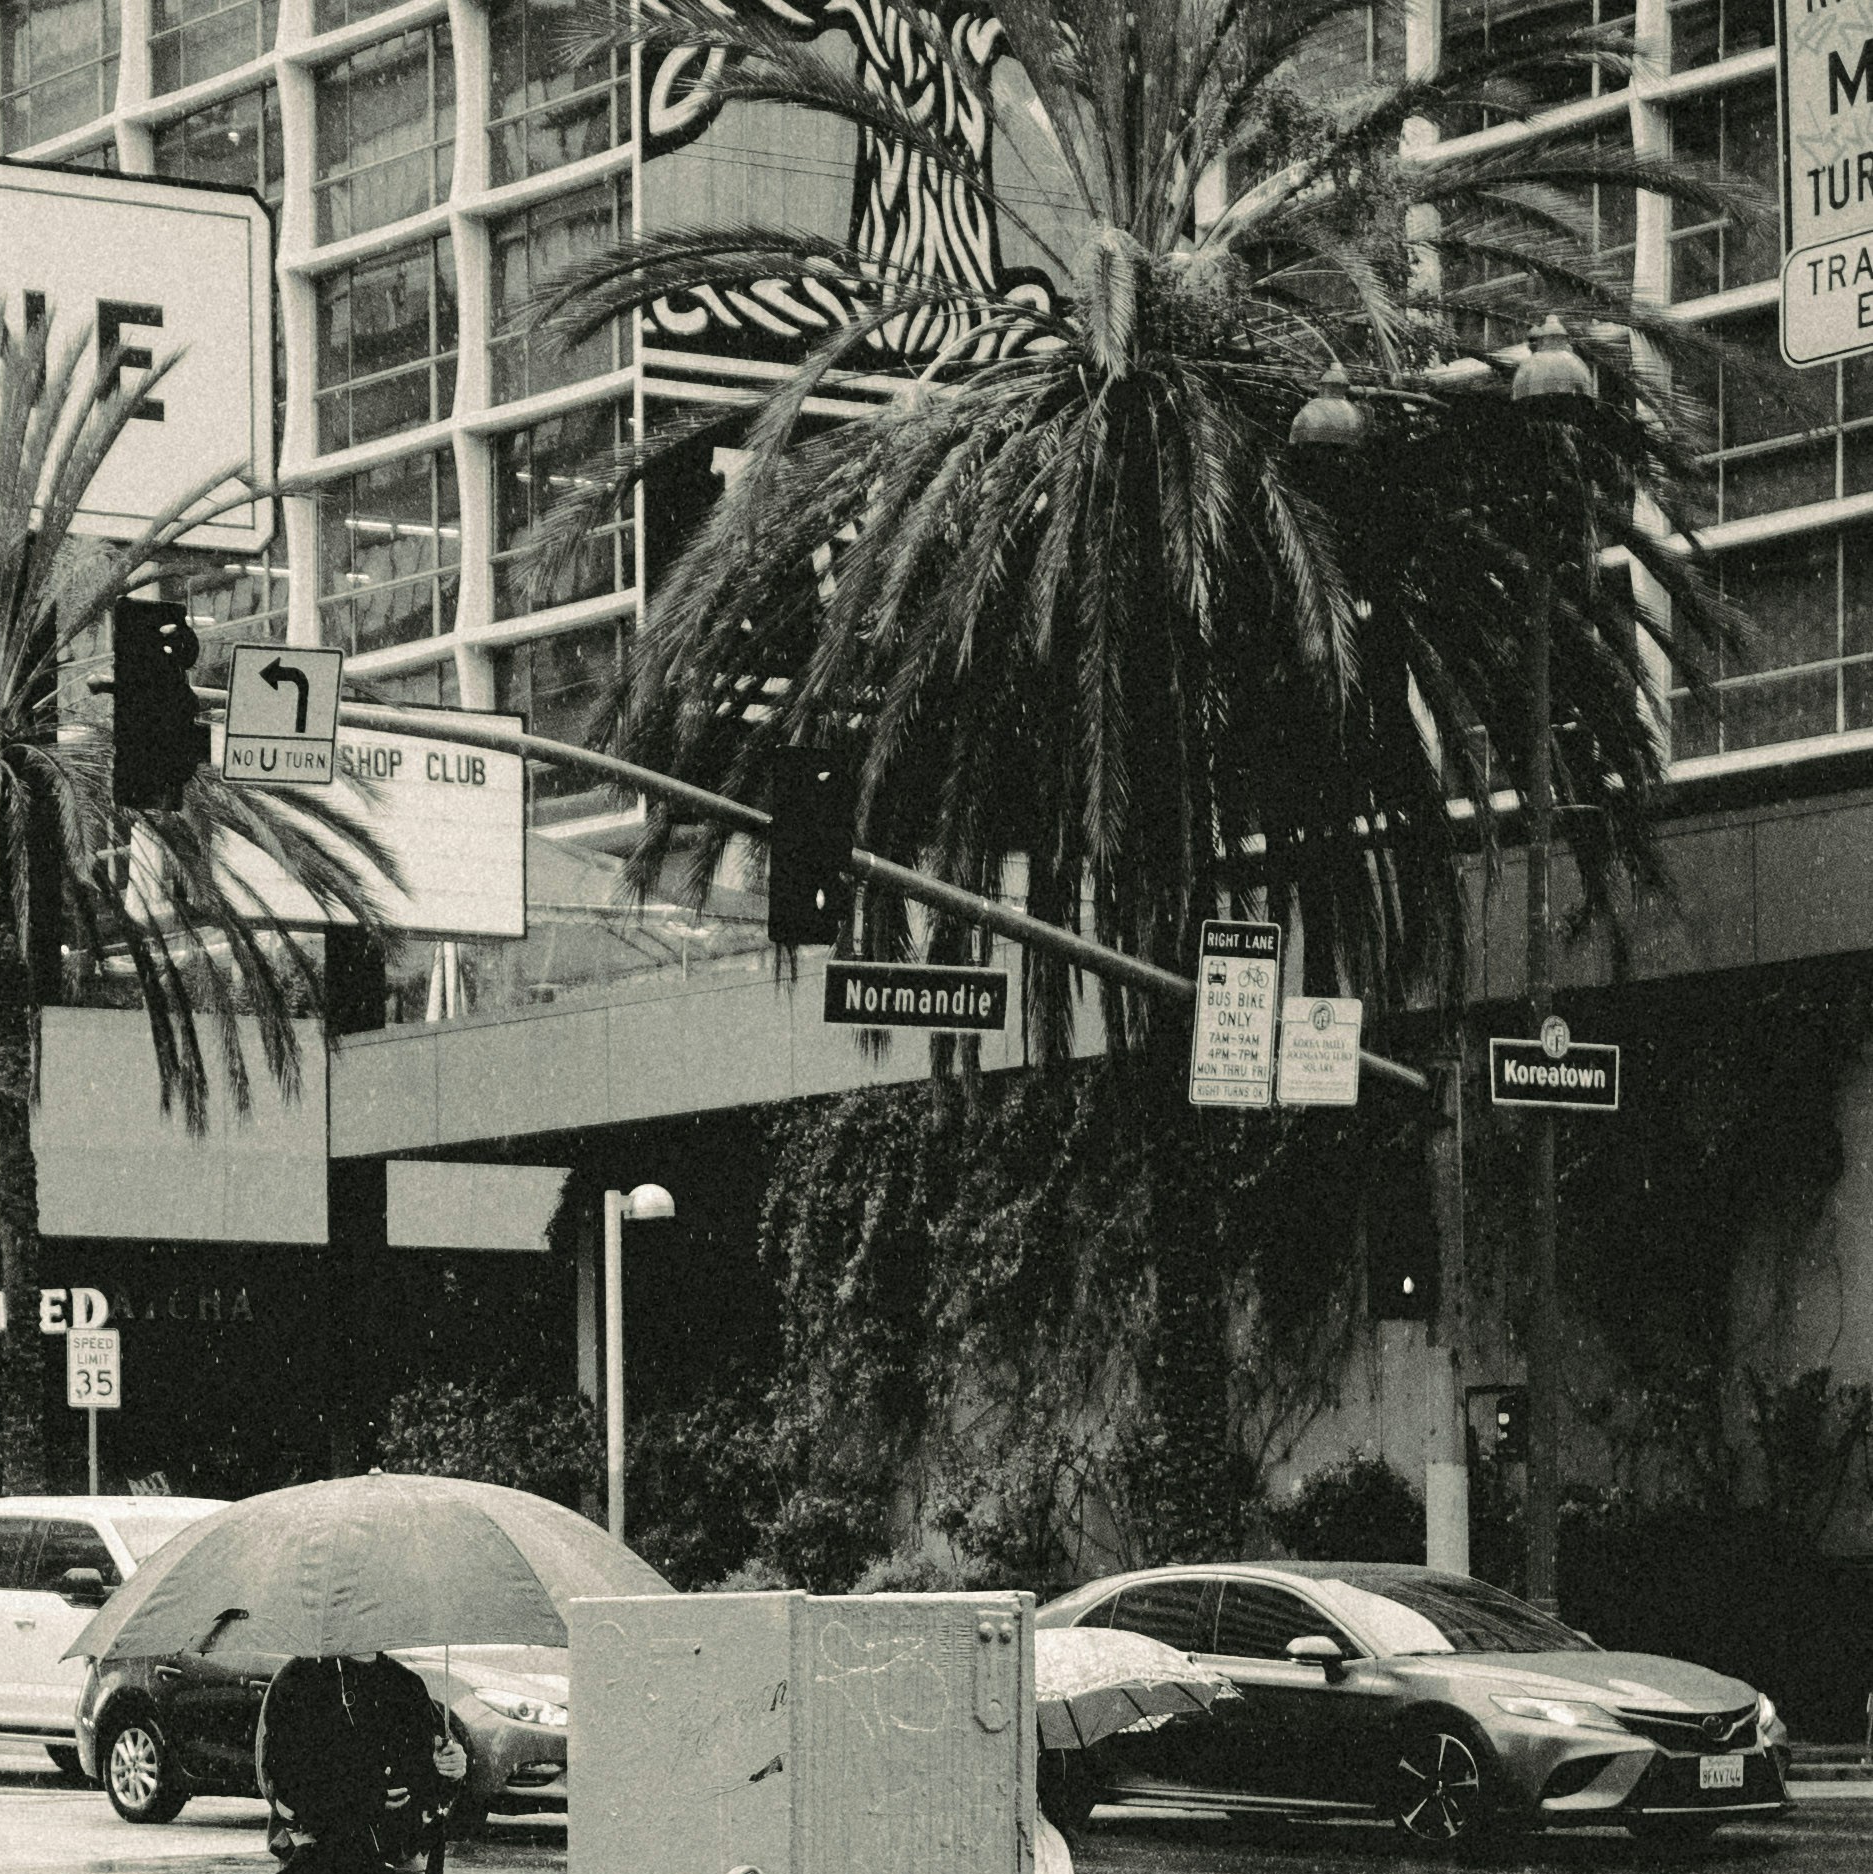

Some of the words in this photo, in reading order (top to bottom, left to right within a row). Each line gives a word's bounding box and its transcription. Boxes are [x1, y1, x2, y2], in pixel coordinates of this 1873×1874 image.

[232, 749, 253, 767] NO
[260, 747, 277, 772] U
[286, 751, 326, 769] TURN
[341, 745, 402, 778] SHOP
[427, 751, 486, 786] CLUB
[1207, 932, 1240, 948] RIGHT
[1245, 934, 1274, 950] LANE
[845, 978, 992, 1018] Normandie
[1207, 990, 1231, 1007] BUS
[1238, 992, 1266, 1009] BIKE
[1218, 1011, 1252, 1027] ONLY
[1196, 1062, 1217, 1075] MON
[1223, 1063, 1247, 1078] THRU
[1252, 1065, 1267, 1078] FRI
[1504, 1058, 1606, 1089] Koreatown
[1197, 1084, 1220, 1096] RIGHT
[1224, 1085, 1249, 1098] TURNS
[73, 1337, 114, 1350] SPEED
[77, 1353, 110, 1365] LIMIT
[75, 1369, 113, 1398] 35
